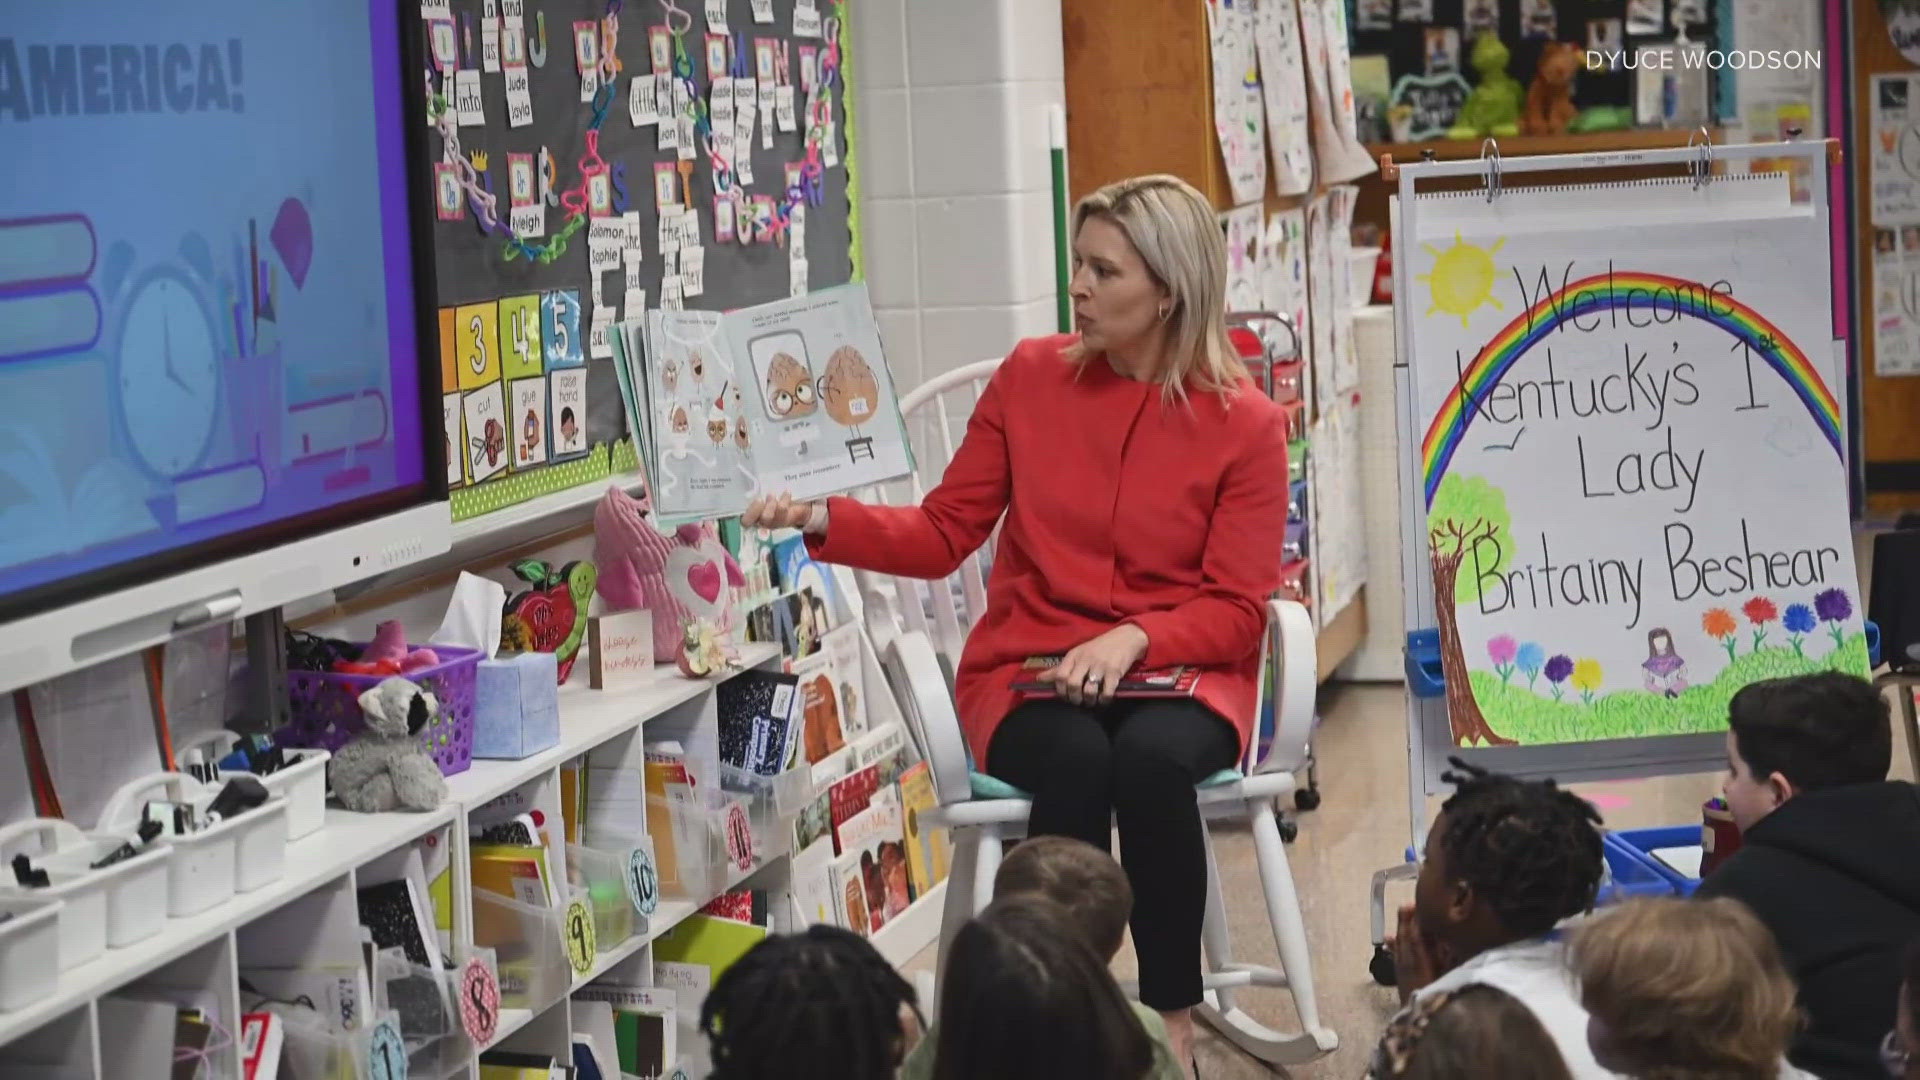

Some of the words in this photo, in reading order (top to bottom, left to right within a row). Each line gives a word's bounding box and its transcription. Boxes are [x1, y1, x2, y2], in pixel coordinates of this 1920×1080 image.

[508, 74, 526, 92] Jude
[592, 247, 618, 265] Sophie
[1512, 259, 1735, 336] Welcome
[470, 314, 487, 375] 3
[511, 304, 529, 365] 4
[553, 301, 569, 358] 5
[477, 396, 492, 415] cut
[521, 389, 537, 407] glue
[558, 388, 579, 403] hand
[1456, 342, 1700, 431] Kentucky's
[1577, 426, 1705, 514] Lady
[1663, 518, 1840, 602] Beshear
[632, 863, 654, 903] 10
[571, 914, 587, 962] 9
[470, 975, 491, 1032] 8
